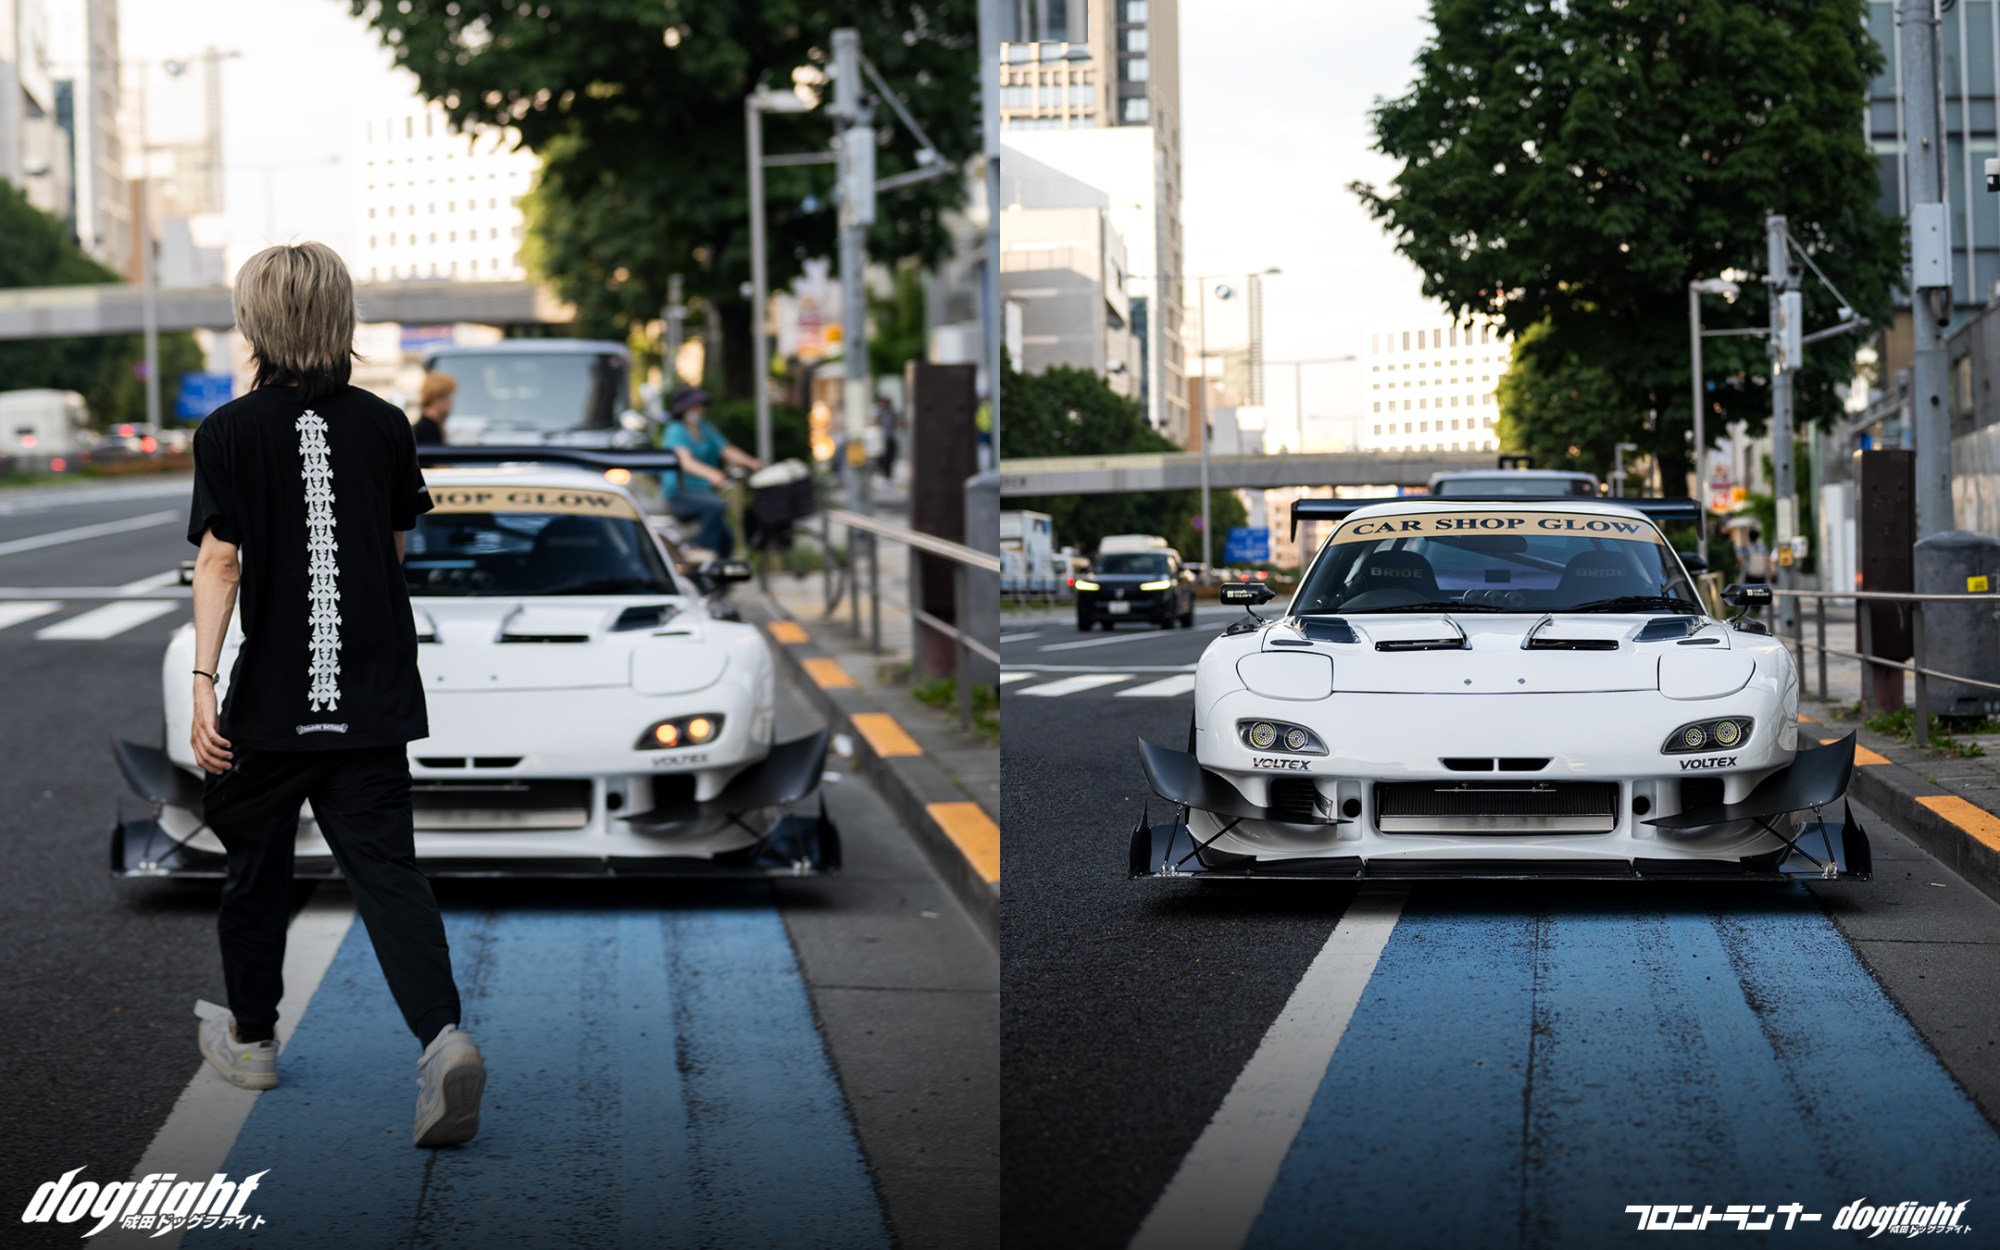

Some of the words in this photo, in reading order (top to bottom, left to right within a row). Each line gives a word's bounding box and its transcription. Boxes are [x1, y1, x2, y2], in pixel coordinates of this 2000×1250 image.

[507, 492, 612, 507] GLOW
[1352, 520, 1423, 535] CAR
[1434, 518, 1525, 530] SHOP
[1537, 518, 1640, 534] GLOW
[1370, 567, 1424, 578] BRIDE
[1575, 567, 1627, 577] BRIDE
[1253, 757, 1311, 770] VOLTEX
[1680, 756, 1737, 770] VOLTEX
